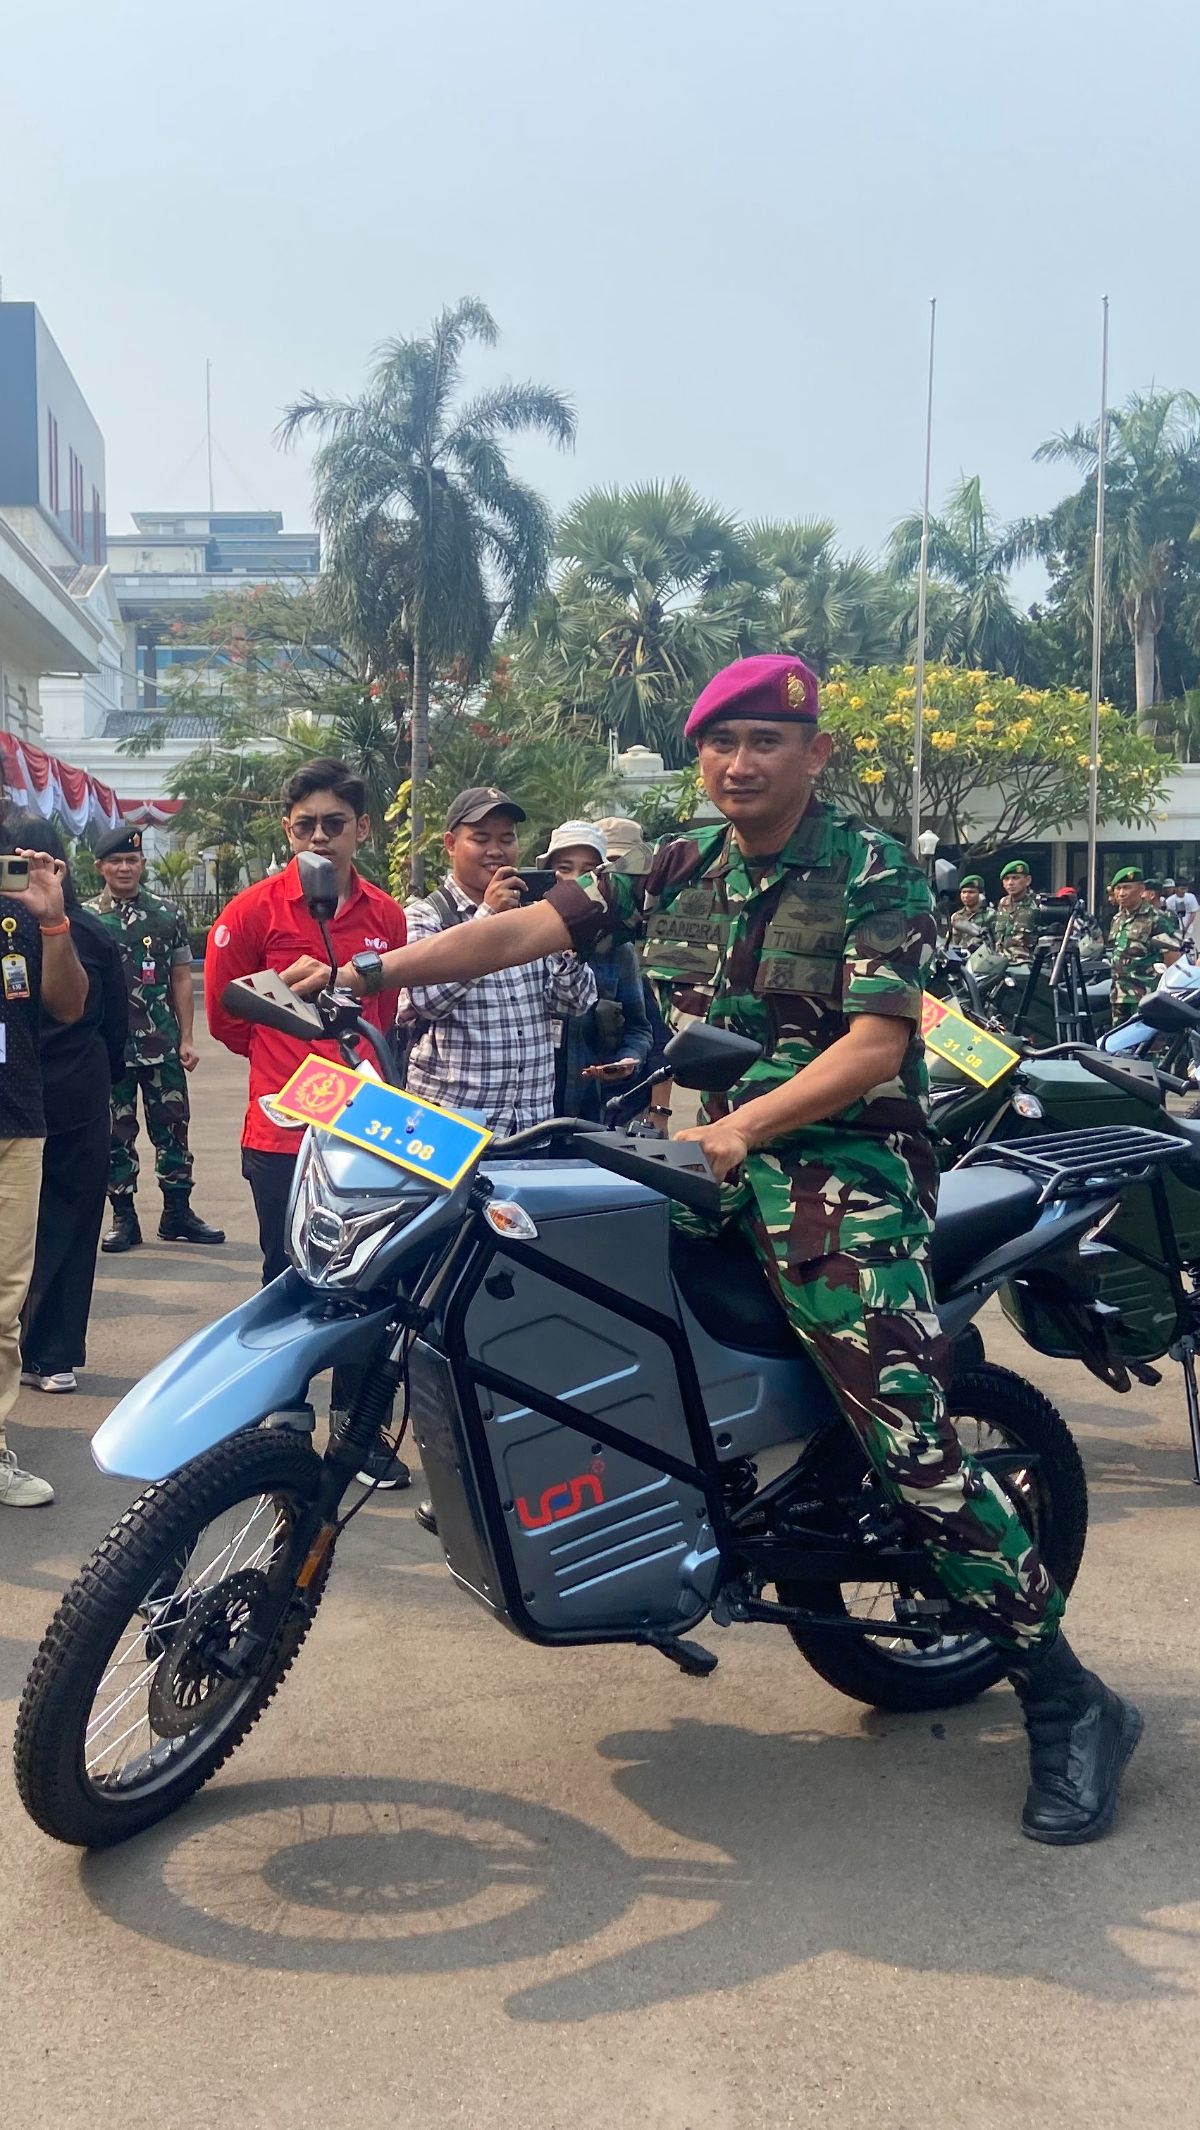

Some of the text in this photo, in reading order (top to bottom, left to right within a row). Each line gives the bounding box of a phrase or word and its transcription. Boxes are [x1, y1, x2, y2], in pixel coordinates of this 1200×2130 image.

[774, 931, 801, 950] TNI
[941, 1038, 960, 1052] 31
[965, 1054, 983, 1068] 08
[365, 1120, 392, 1141] 31
[406, 1139, 435, 1161] 08
